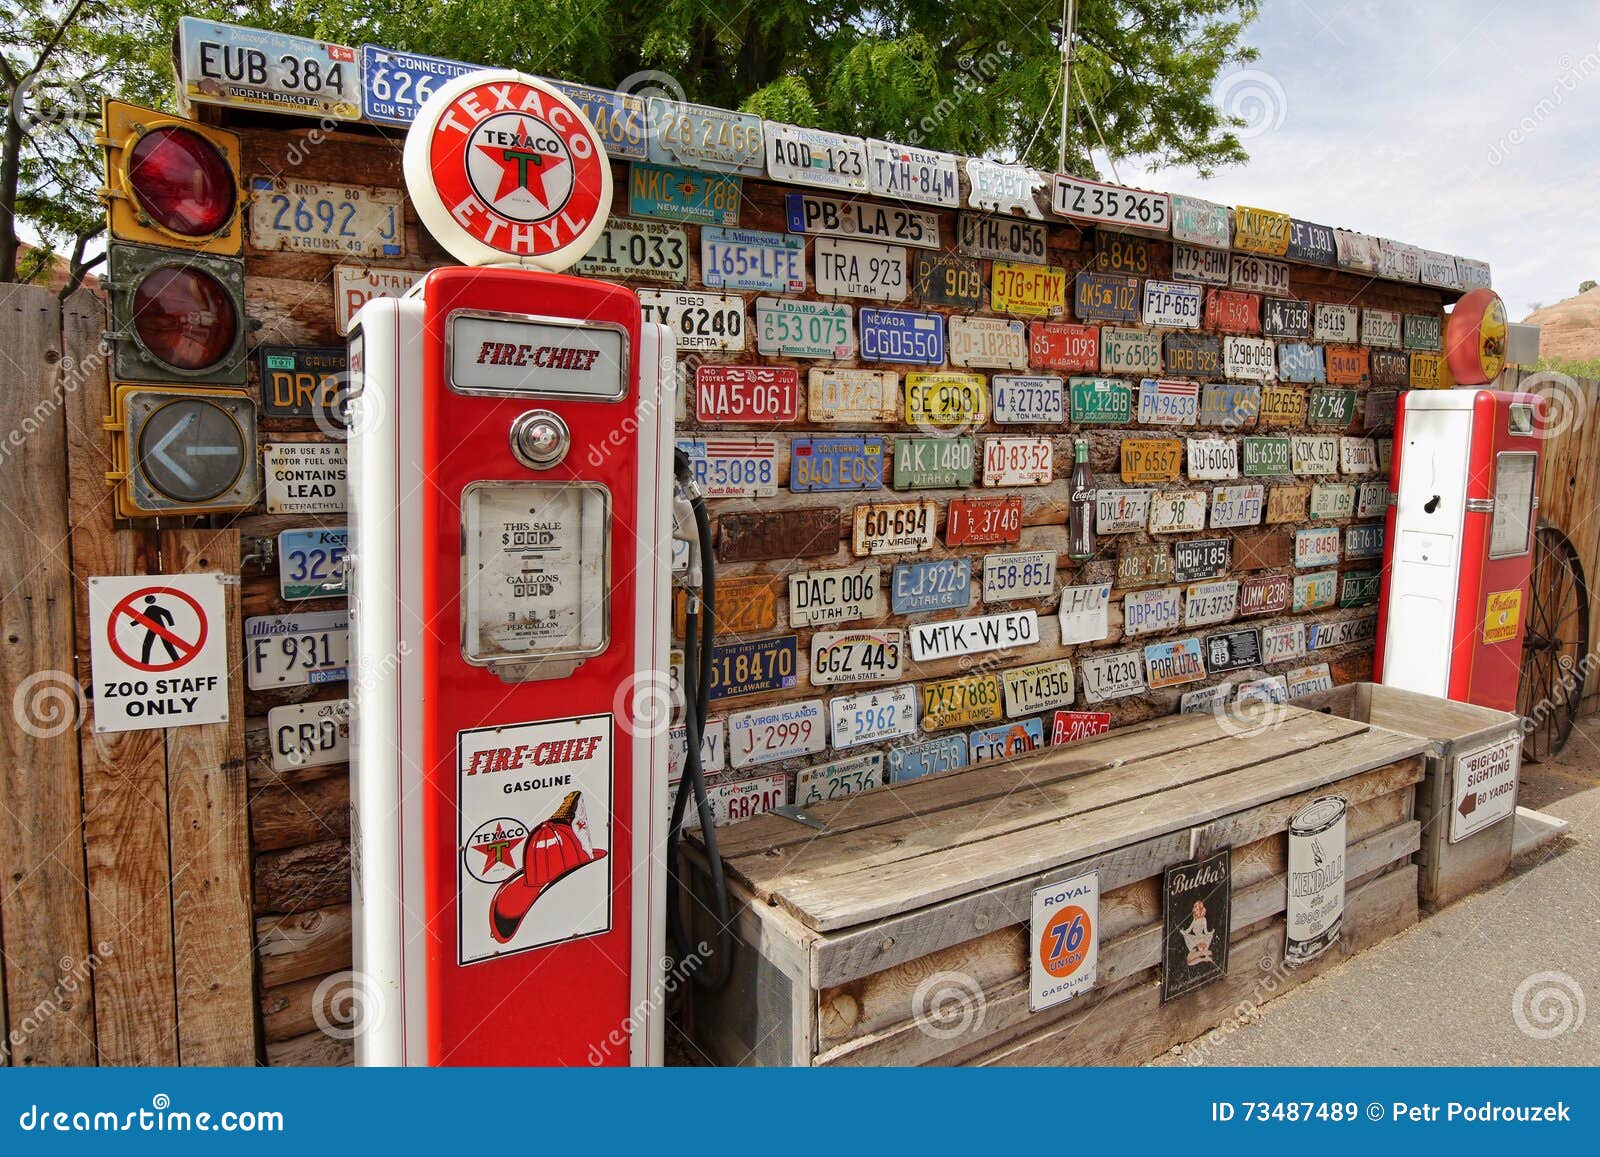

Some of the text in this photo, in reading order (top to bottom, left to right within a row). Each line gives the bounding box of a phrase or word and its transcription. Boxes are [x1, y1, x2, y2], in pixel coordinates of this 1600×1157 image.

[200, 41, 343, 95] EUB 384
[229, 87, 272, 102] NORTH
[274, 93, 320, 106] DAKOTA
[438, 84, 592, 160] TEXACO
[484, 130, 559, 154] TEXACO
[796, 130, 841, 146] TENNESSEE
[775, 139, 862, 176] AQD 123
[910, 152, 937, 166] TEXAS
[503, 151, 541, 189] T
[875, 159, 911, 191] TXH
[919, 167, 955, 198] 84M
[634, 168, 738, 211] NKC 788
[657, 203, 714, 217] NEW MEXICO
[1058, 182, 1085, 213] TZ
[1091, 189, 1119, 217] 35
[1124, 195, 1165, 223] 265
[271, 195, 396, 239] 2692 J
[452, 195, 586, 254] ETHYL
[804, 200, 923, 241] PB LA 25
[292, 236, 339, 249] TRUCK
[732, 232, 779, 247] Minnesota
[963, 216, 1044, 257] UTH 056
[1111, 243, 1147, 272] 843
[584, 264, 680, 279] LAND OPPORTUNITY
[821, 252, 901, 287] TRA 923
[369, 275, 413, 289] UTAH
[848, 285, 877, 295] UTAH
[946, 271, 981, 299] 909
[675, 296, 704, 307] 1963
[783, 303, 816, 314] IDAHO
[681, 309, 741, 336] 6240
[867, 315, 905, 327] NEVADA
[1284, 309, 1308, 329] 7358
[810, 317, 847, 345] 075
[865, 328, 938, 358] CGD550
[476, 342, 600, 371] FIRE-CHIEF
[910, 386, 932, 412] SE
[939, 386, 982, 413] 9081
[1018, 389, 1061, 413] 27325
[1032, 412, 1046, 420] MILE
[817, 446, 860, 454] CALIFORNIA
[900, 443, 971, 472] AK 1480
[1296, 441, 1315, 462] KDK
[797, 456, 879, 484] 840 EOS
[1125, 451, 1176, 471] NP 6567
[275, 470, 347, 481] CONTAINS
[913, 474, 957, 485] UTAH 67
[288, 484, 336, 498] LEAD
[504, 522, 562, 531] THIS SALE
[982, 509, 1019, 533] 3748
[861, 537, 928, 548] 1967 VIRGINIA
[1002, 556, 1041, 565] MINNESOTA
[507, 575, 559, 585] GALLONS
[796, 577, 835, 608] DAC
[842, 574, 874, 602] 006
[911, 595, 938, 607] UTAH
[812, 606, 859, 620] UTAH 73
[253, 621, 299, 636] Illinois
[507, 621, 559, 631] PER GALLON
[1006, 615, 1031, 641] 50
[845, 634, 871, 643] HAWAII
[281, 634, 335, 671] 931
[817, 644, 898, 674] GGZ 443
[1214, 653, 1226, 664] 66
[104, 676, 218, 698] ZOO STAFF
[834, 672, 878, 682] ALOHA STATE
[727, 681, 771, 695] DELAWARE
[1100, 682, 1129, 693] MONTANA
[126, 697, 198, 717] ONLY
[892, 694, 906, 702] 1992
[1024, 700, 1058, 711] Garden State
[752, 708, 817, 727] VIRGIN ISLANDS
[855, 705, 896, 735] 5962
[933, 709, 995, 726] FRONT TAMPS
[877, 728, 897, 737] VEHICLE
[466, 736, 602, 776] FIRE-CHIEF
[810, 761, 870, 780] NEW HAMPSHIRE
[1467, 759, 1510, 787] SIGHTING
[503, 775, 572, 794] GASOLINE
[719, 783, 758, 797] Georgia
[1489, 780, 1514, 801] YARDS
[475, 827, 524, 844] TEXACO
[1171, 860, 1226, 896] Bubba's
[1292, 855, 1344, 898] KENDALL
[1044, 885, 1092, 907] ROYAL
[1049, 914, 1084, 960] 76
[1050, 952, 1083, 971] UNION
[1042, 973, 1090, 997] GASOLINE
